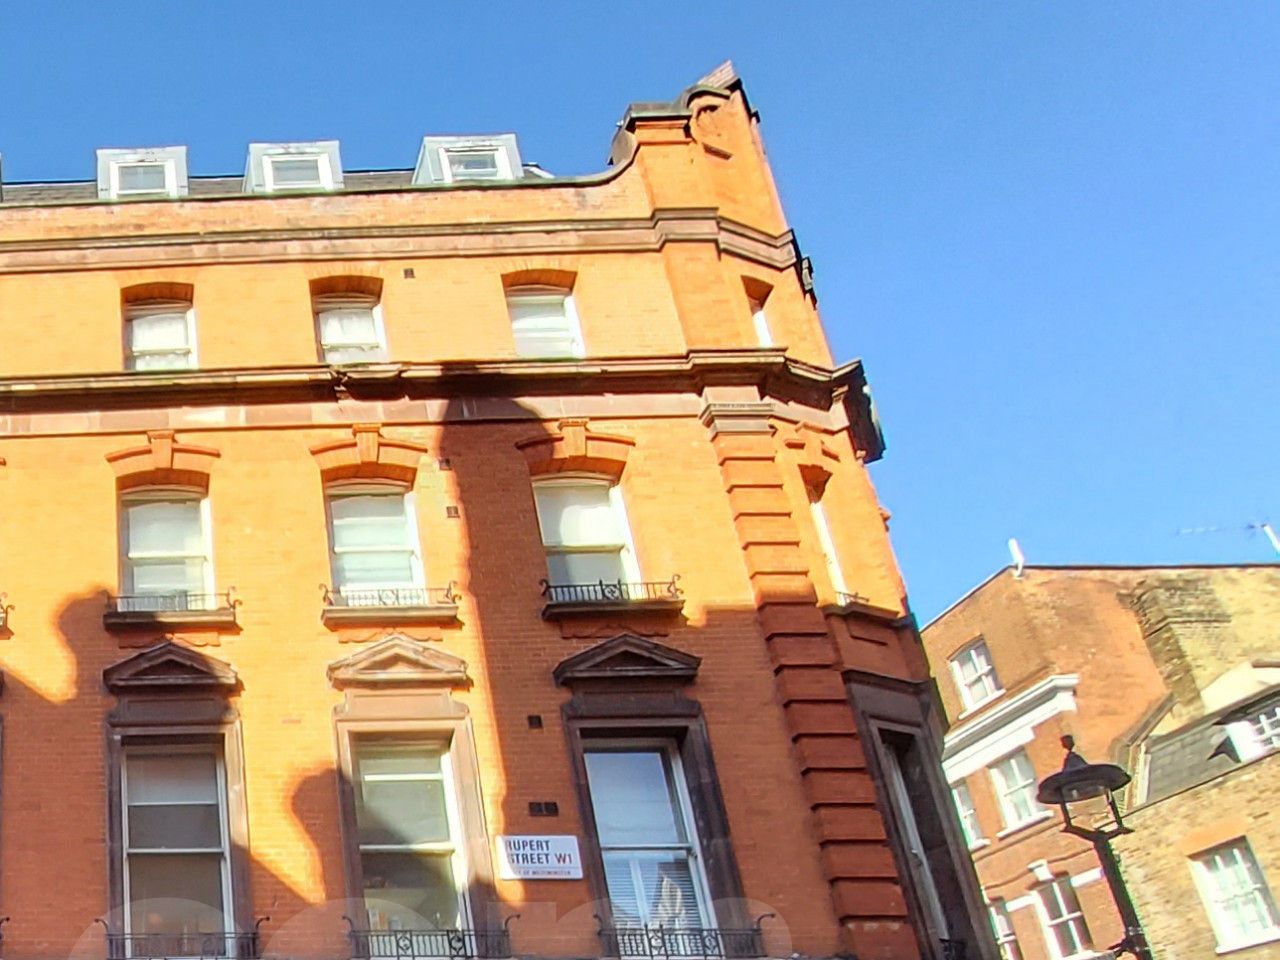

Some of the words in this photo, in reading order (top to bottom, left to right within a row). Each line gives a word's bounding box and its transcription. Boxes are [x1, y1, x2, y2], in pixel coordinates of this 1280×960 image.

[506, 840, 551, 852] RUPERT
[511, 853, 550, 864] STREET
[555, 853, 572, 864] W1
